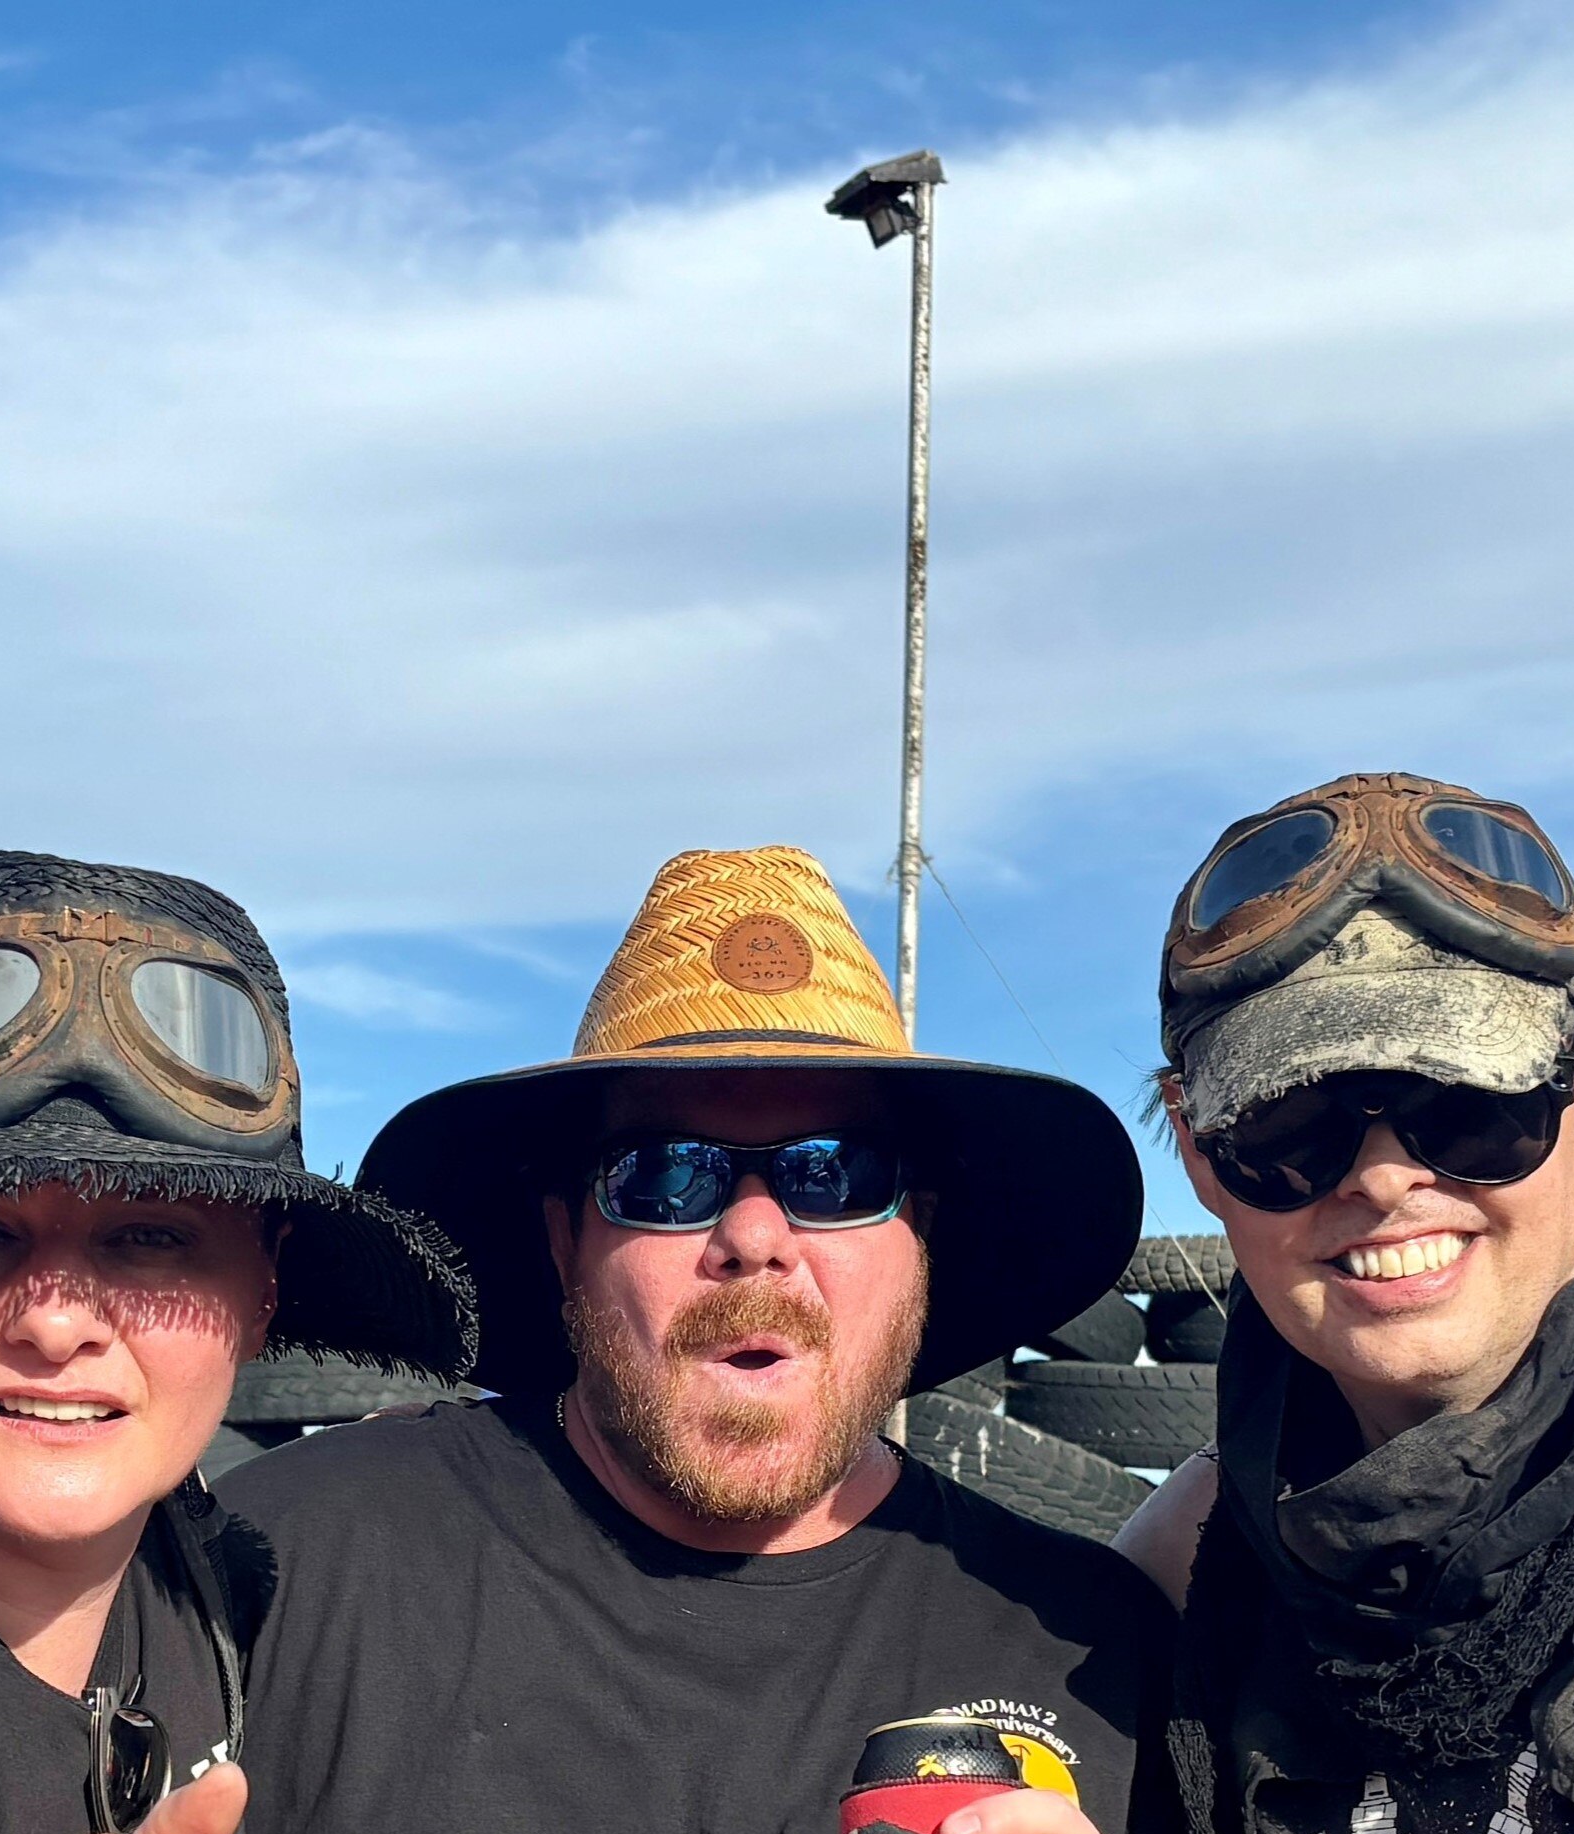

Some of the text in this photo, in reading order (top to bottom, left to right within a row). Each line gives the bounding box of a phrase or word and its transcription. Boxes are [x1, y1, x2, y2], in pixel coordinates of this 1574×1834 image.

[952, 1698, 1058, 1727] MAD MAX 2
